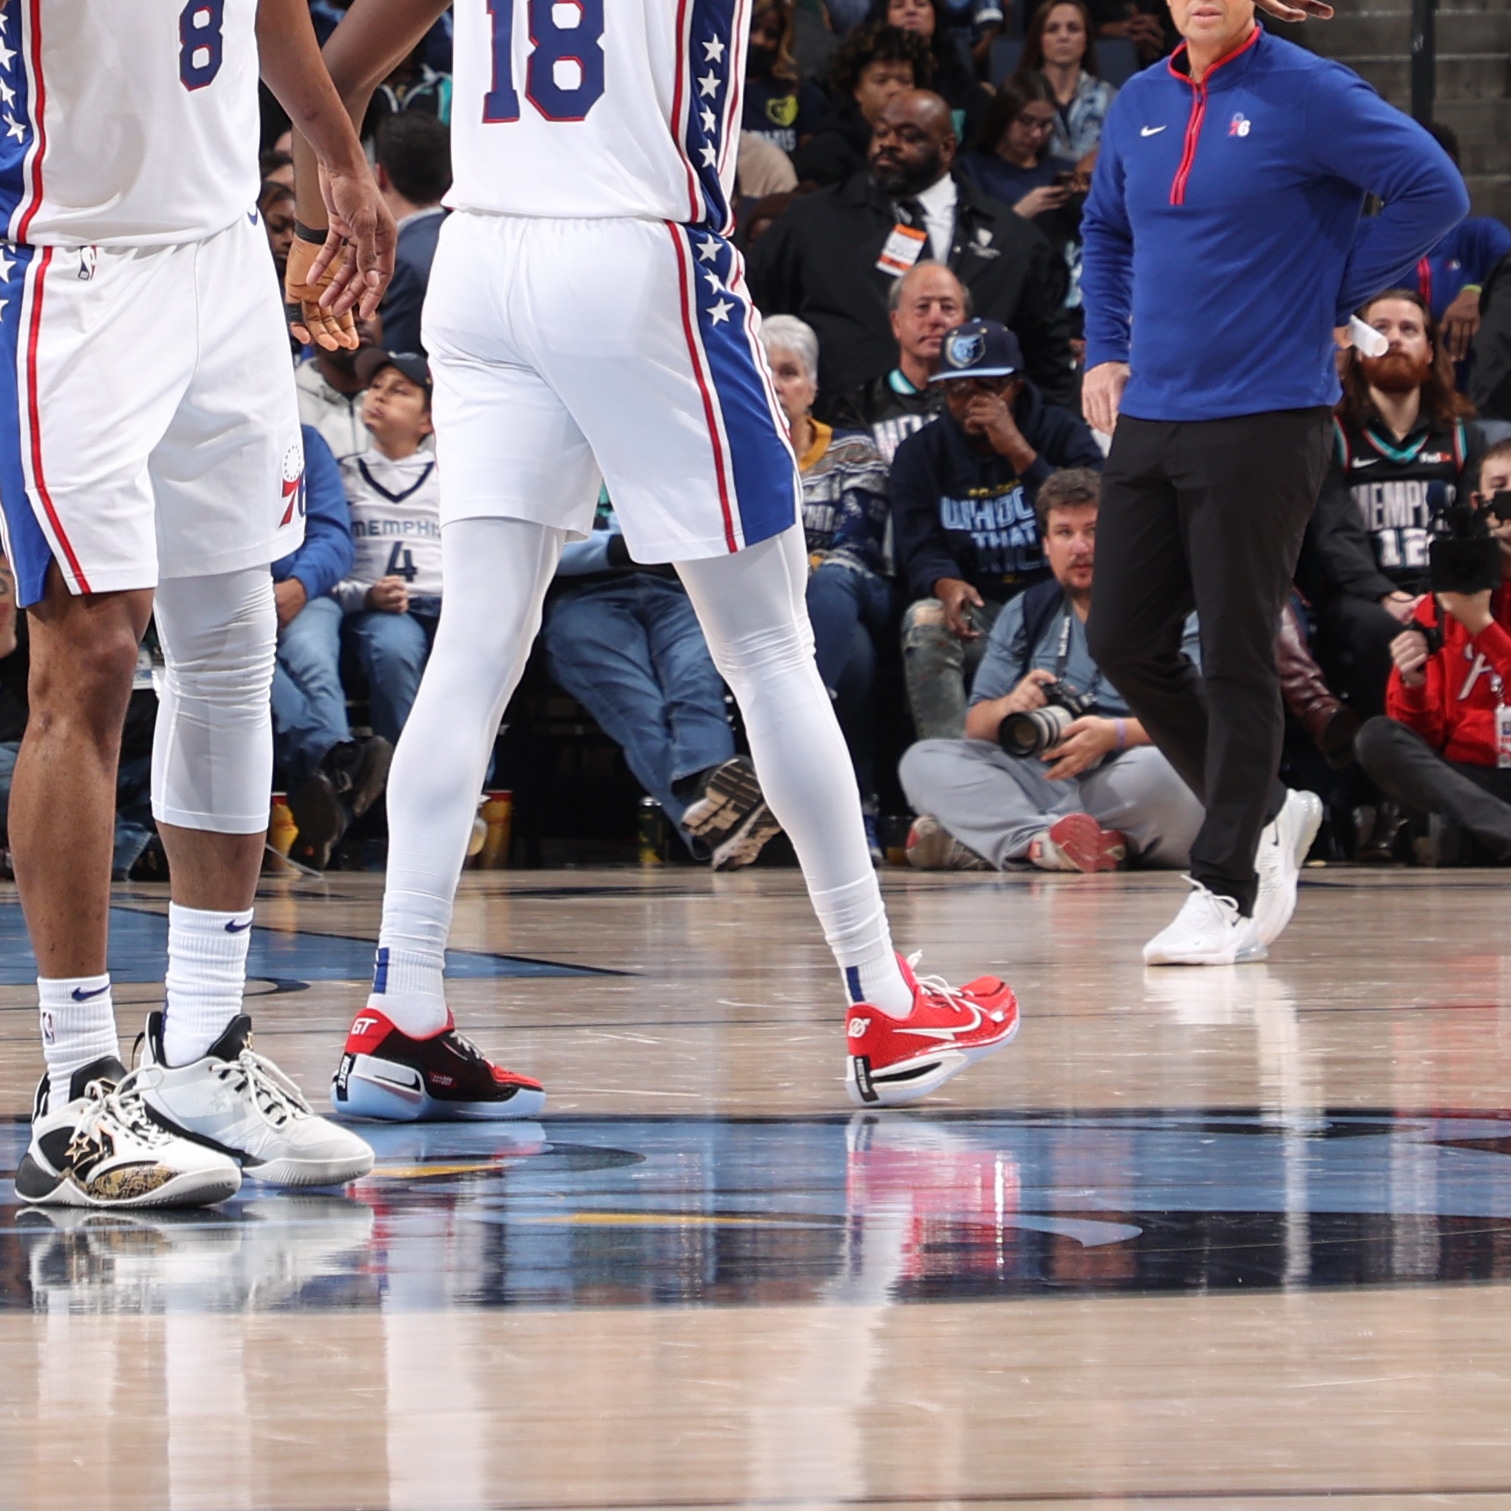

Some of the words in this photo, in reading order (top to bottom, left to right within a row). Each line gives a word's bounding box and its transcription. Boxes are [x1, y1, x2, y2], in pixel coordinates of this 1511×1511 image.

[1354, 482, 1454, 531] MEMP
[971, 519, 1037, 549] THAT
[1378, 528, 1430, 568] 12
[386, 541, 417, 583] 4
[351, 1017, 378, 1035] GT
